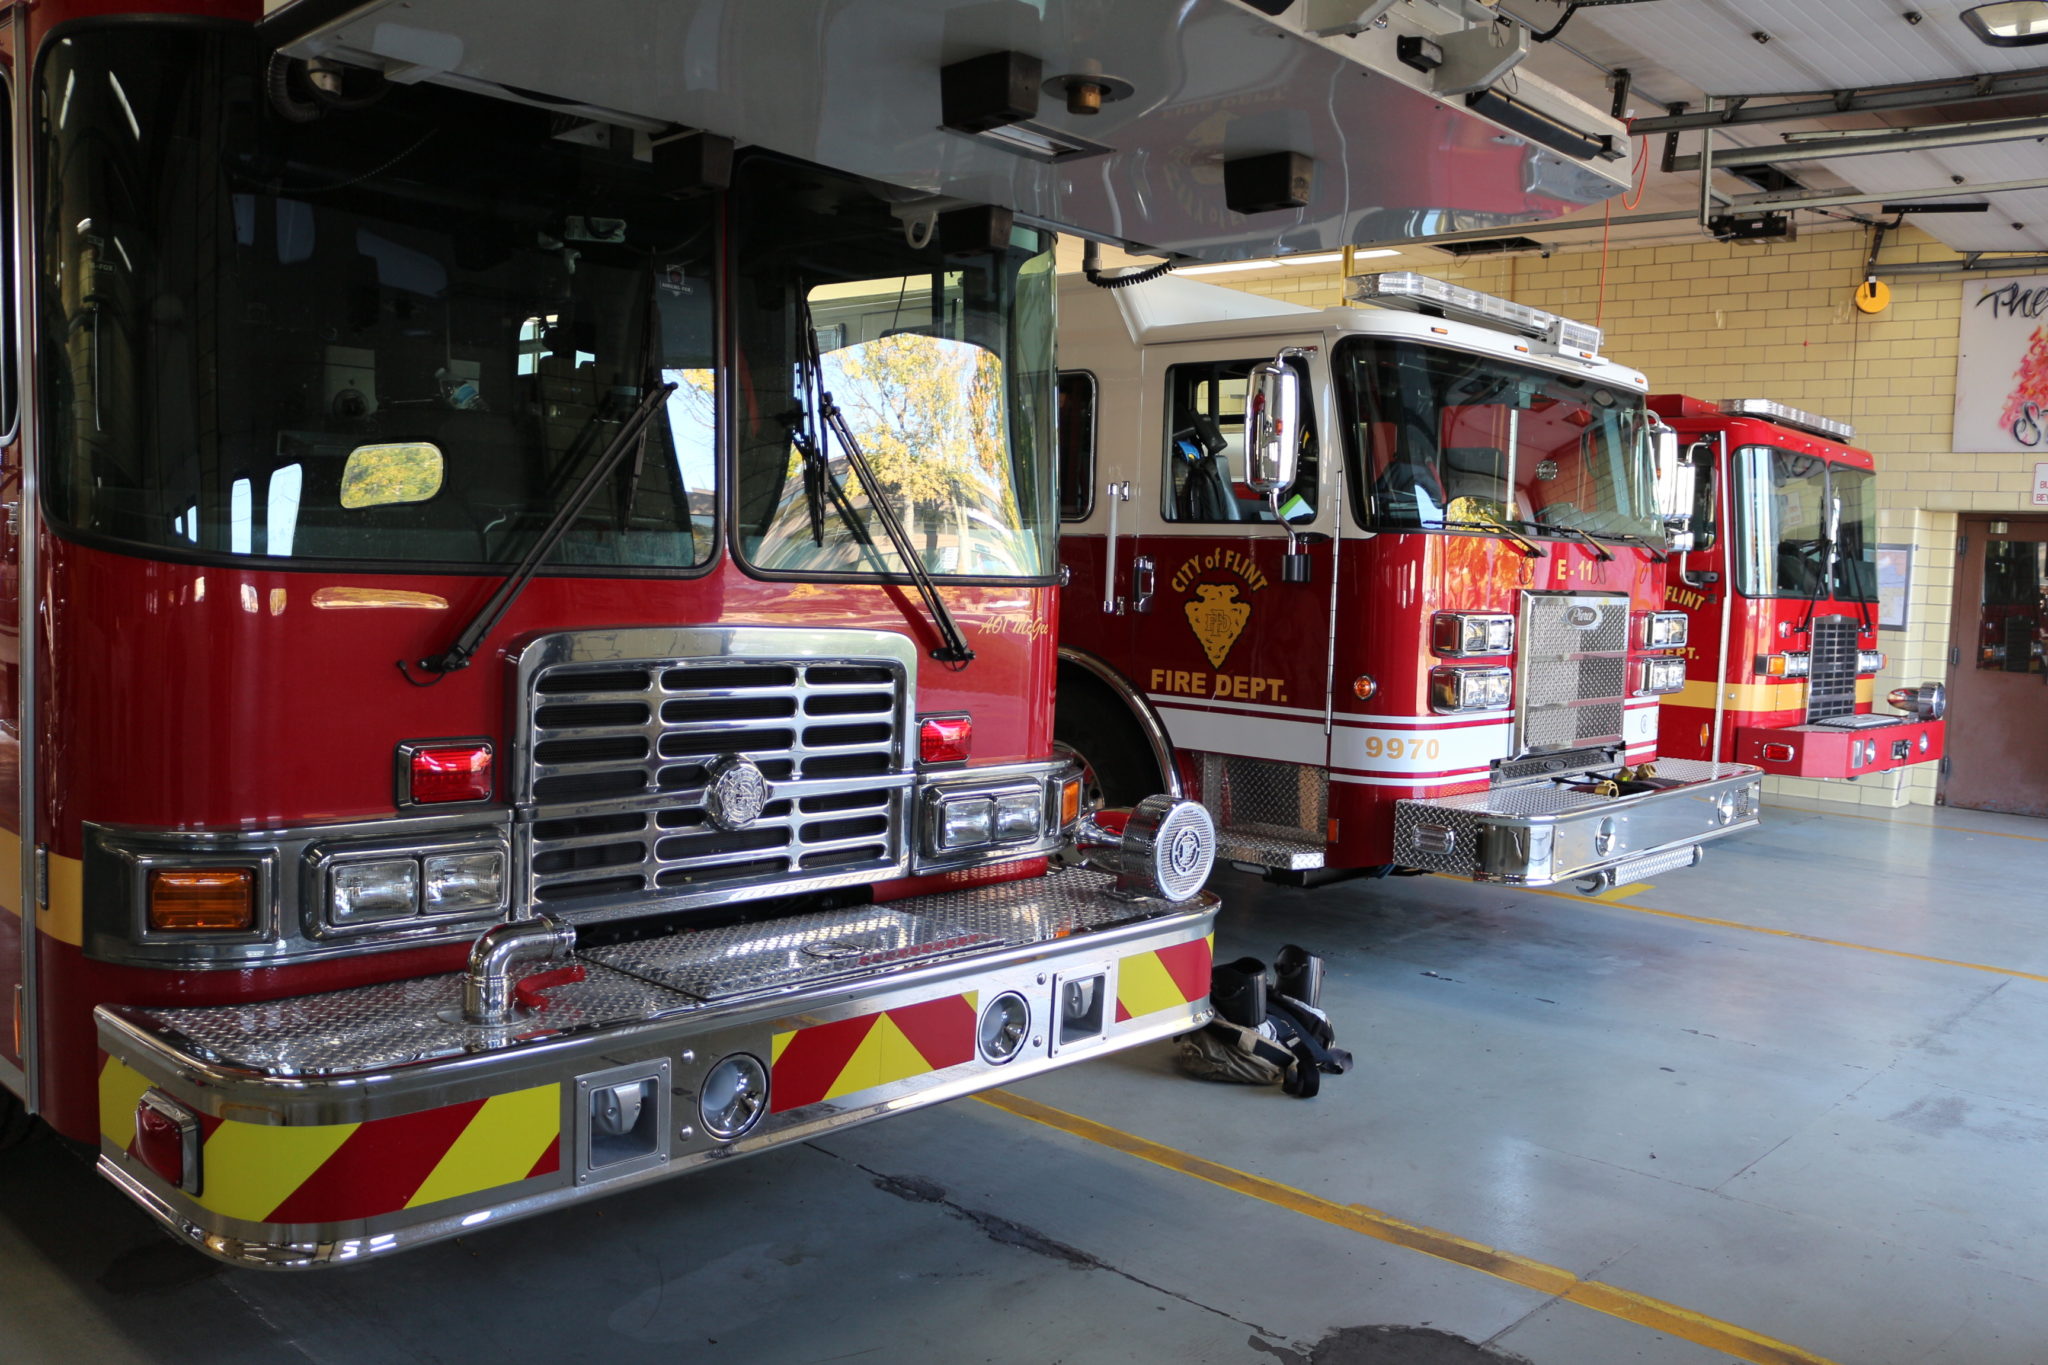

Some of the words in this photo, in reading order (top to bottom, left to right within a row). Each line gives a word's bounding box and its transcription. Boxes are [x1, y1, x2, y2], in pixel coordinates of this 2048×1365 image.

[1171, 555, 1202, 592] CITY
[1205, 547, 1221, 570] of
[1225, 549, 1268, 592] FLINT
[1665, 585, 1705, 611] FLINT
[1663, 646, 1700, 660] EPT.
[1150, 668, 1207, 695] FIRE
[1215, 674, 1288, 702] DEPT.
[1364, 735, 1440, 760] 9970
